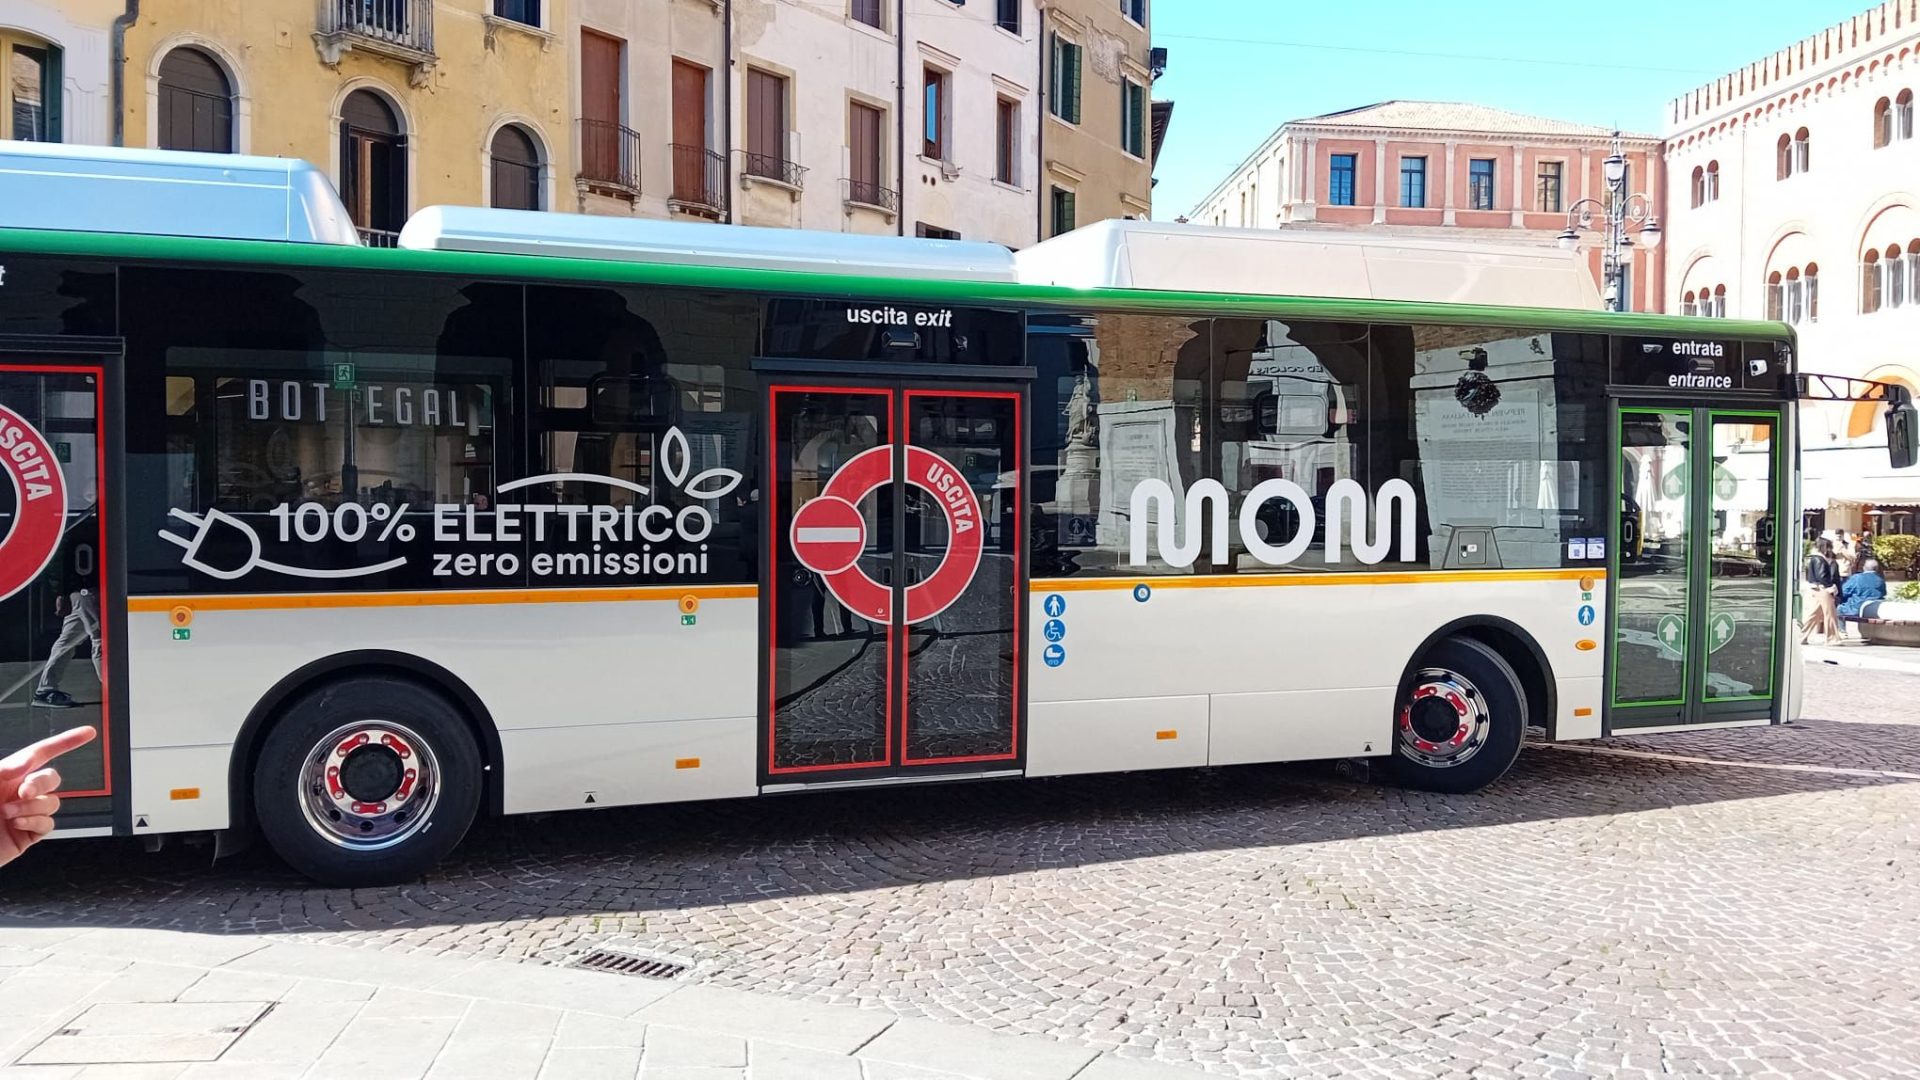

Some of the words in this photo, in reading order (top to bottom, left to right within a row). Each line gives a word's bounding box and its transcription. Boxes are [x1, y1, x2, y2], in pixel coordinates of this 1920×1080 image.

[847, 306, 908, 325] uscita
[914, 309, 952, 327] exit
[1672, 340, 1723, 357] entrata
[1668, 372, 1732, 388] entrance
[926, 463, 974, 534] USCITA
[269, 502, 416, 543] 100%
[434, 504, 713, 543] ELETTRICO
[1130, 478, 1417, 567] MOM
[433, 552, 520, 576] zero
[531, 544, 708, 576] emissioni
